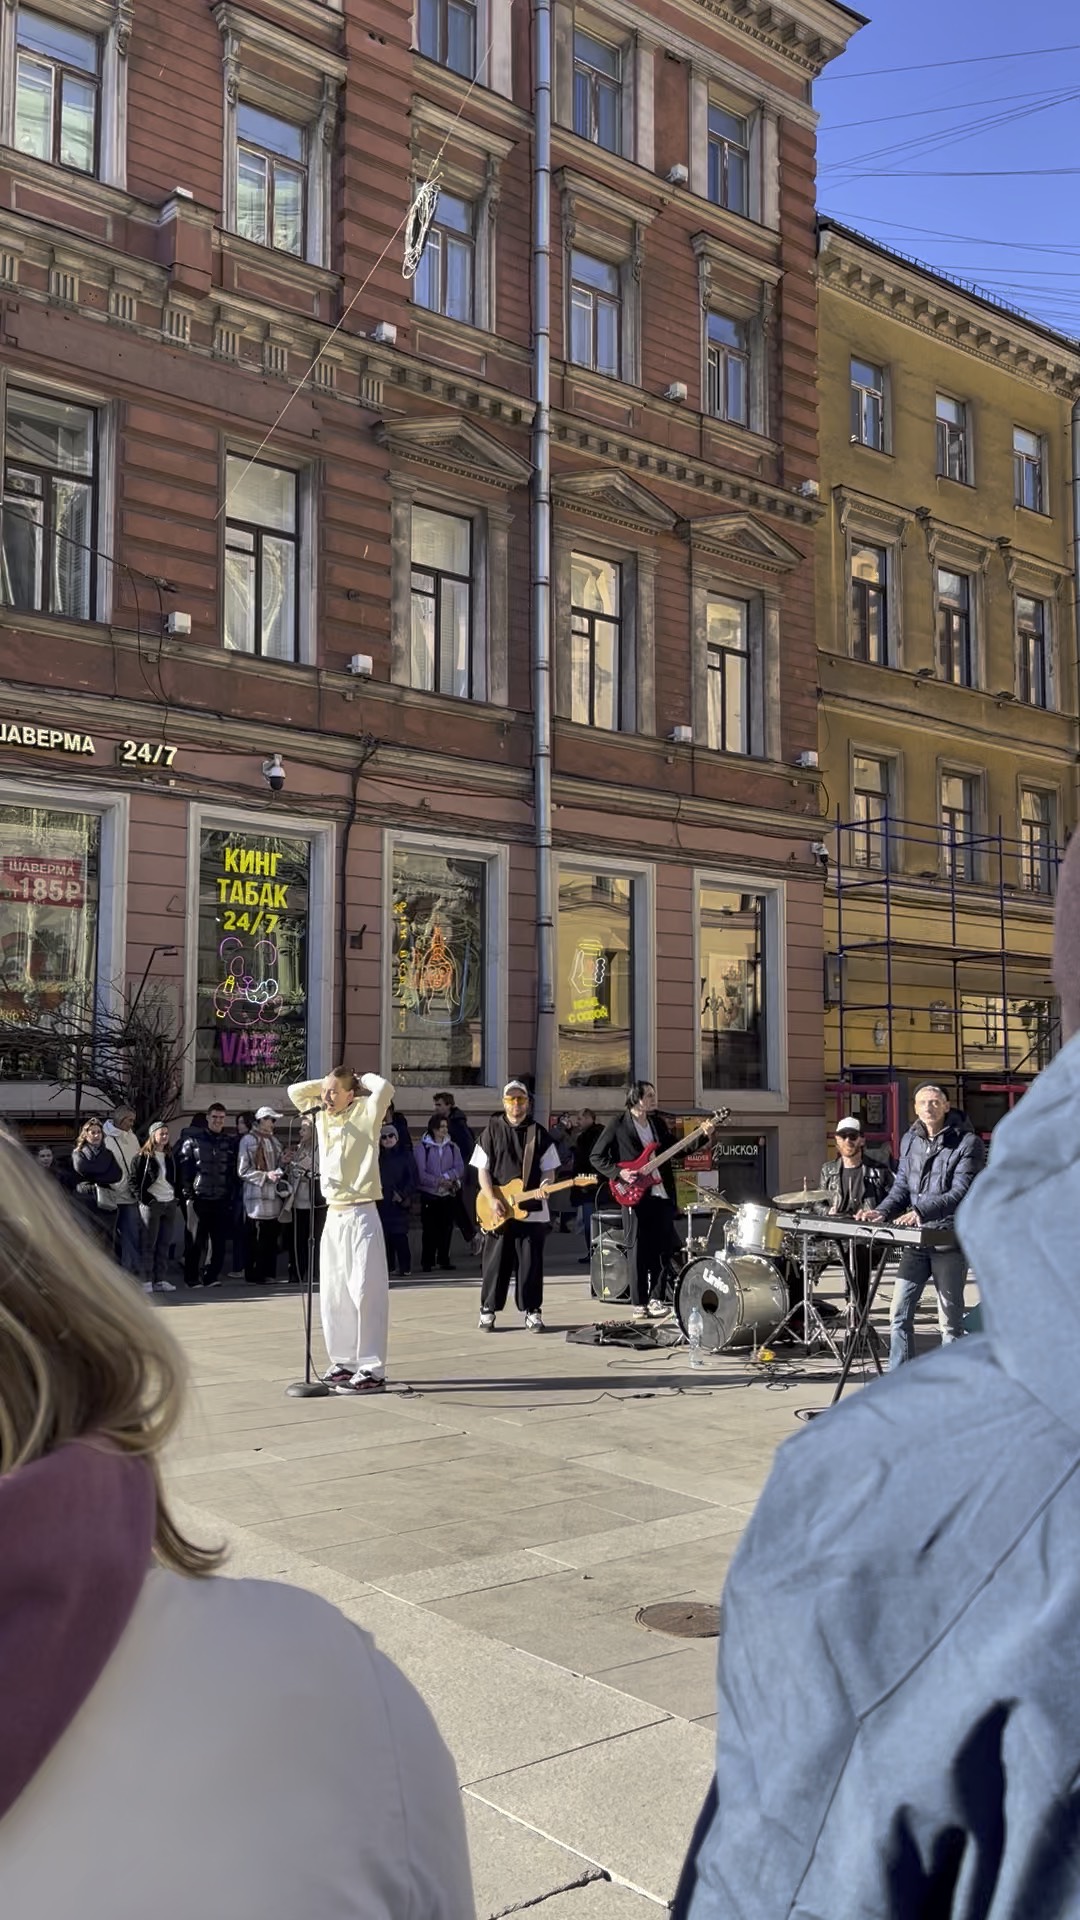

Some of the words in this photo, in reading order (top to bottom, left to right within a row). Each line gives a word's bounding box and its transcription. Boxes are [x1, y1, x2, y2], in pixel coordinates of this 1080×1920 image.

[123, 740, 178, 765] 24/7
[9, 860, 75, 876] ШАВЕРМА
[224, 847, 283, 877] КИНГ
[217, 878, 289, 909] ТАБАК
[223, 910, 279, 935] 24/7
